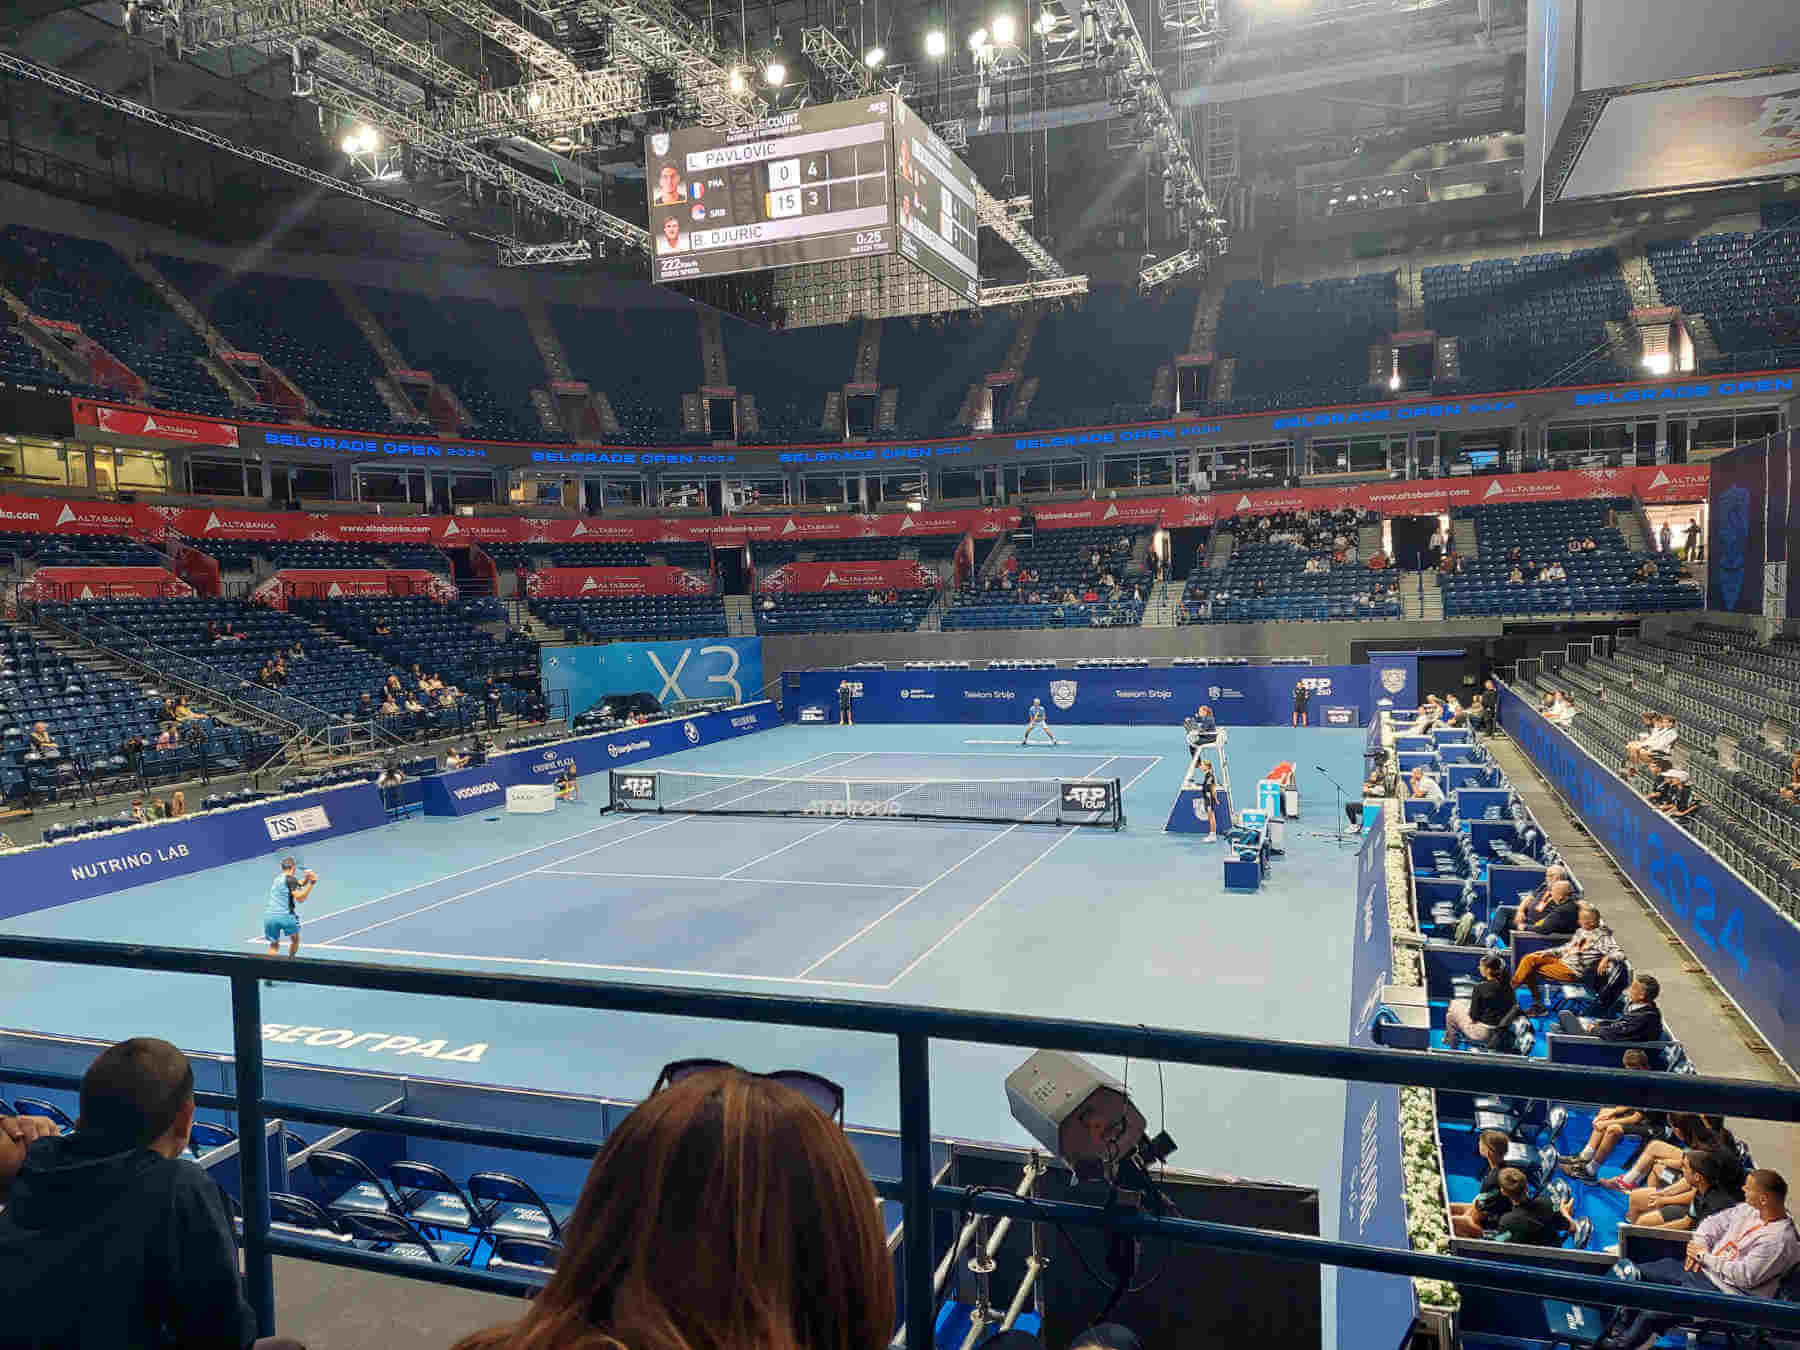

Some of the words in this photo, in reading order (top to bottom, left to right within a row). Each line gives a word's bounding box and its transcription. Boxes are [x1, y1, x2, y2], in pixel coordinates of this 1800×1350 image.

[779, 165, 790, 181] 0
[807, 160, 818, 177] 4
[778, 193, 796, 210] 15
[807, 191, 819, 206] 3
[711, 224, 764, 245] DJURIC
[661, 258, 681, 271] 222
[1575, 384, 1711, 406] BELGRADE
[1717, 378, 1793, 396] OPEN
[1272, 409, 1392, 430] BELGRADE
[1396, 404, 1462, 420] OPEN
[1119, 426, 1176, 440] OPEN
[264, 431, 377, 453] BELGRADE
[383, 442, 442, 457] OPEN
[531, 450, 636, 465] BELGRADE
[640, 453, 694, 465] OPEN
[647, 645, 742, 704] X3
[621, 777, 653, 792] ATP
[1063, 787, 1105, 801] ATP
[1081, 799, 1105, 809] TOUR
[271, 817, 297, 835] TSS
[71, 849, 153, 881] NUTRINO
[157, 843, 190, 863] LAB
[1647, 831, 1750, 983] 2024
